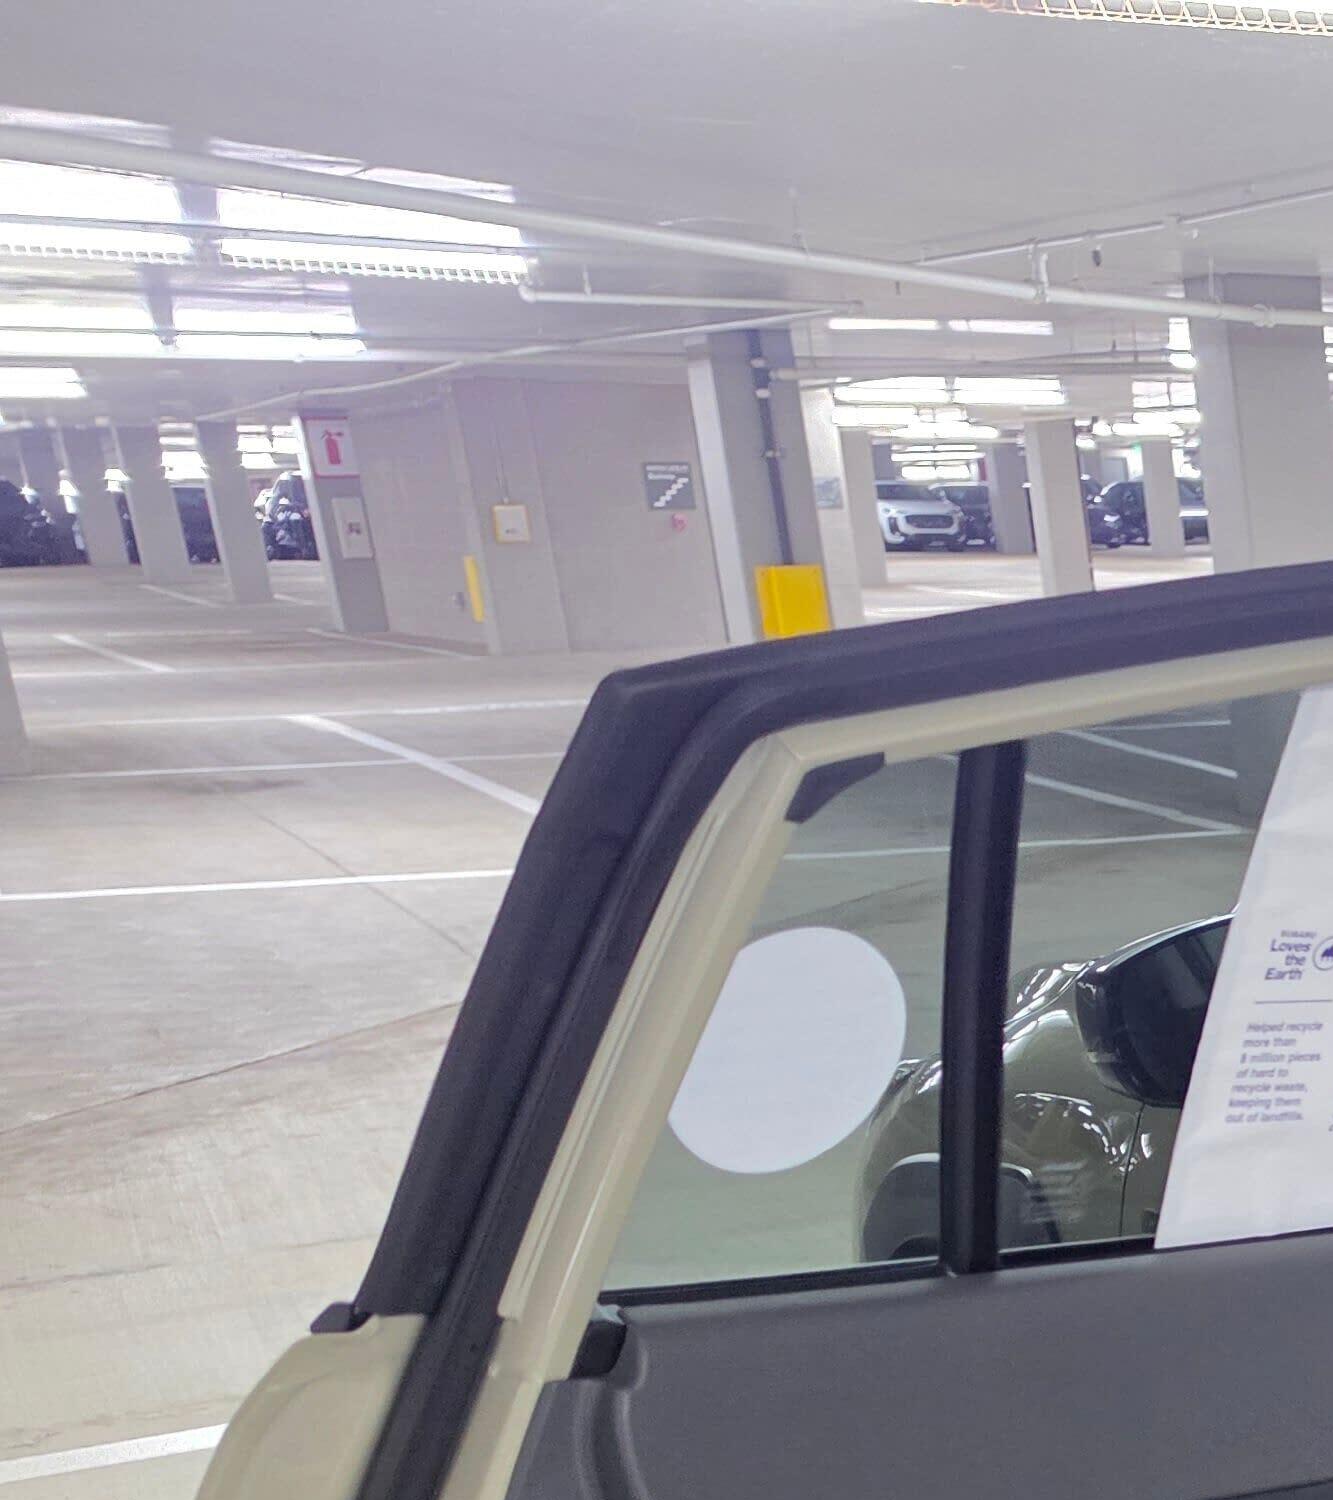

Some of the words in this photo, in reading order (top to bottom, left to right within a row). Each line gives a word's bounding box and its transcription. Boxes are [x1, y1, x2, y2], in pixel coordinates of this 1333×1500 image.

[1271, 939, 1311, 952] Loves
[1285, 954, 1306, 966] the
[1265, 968, 1303, 980] Earth
